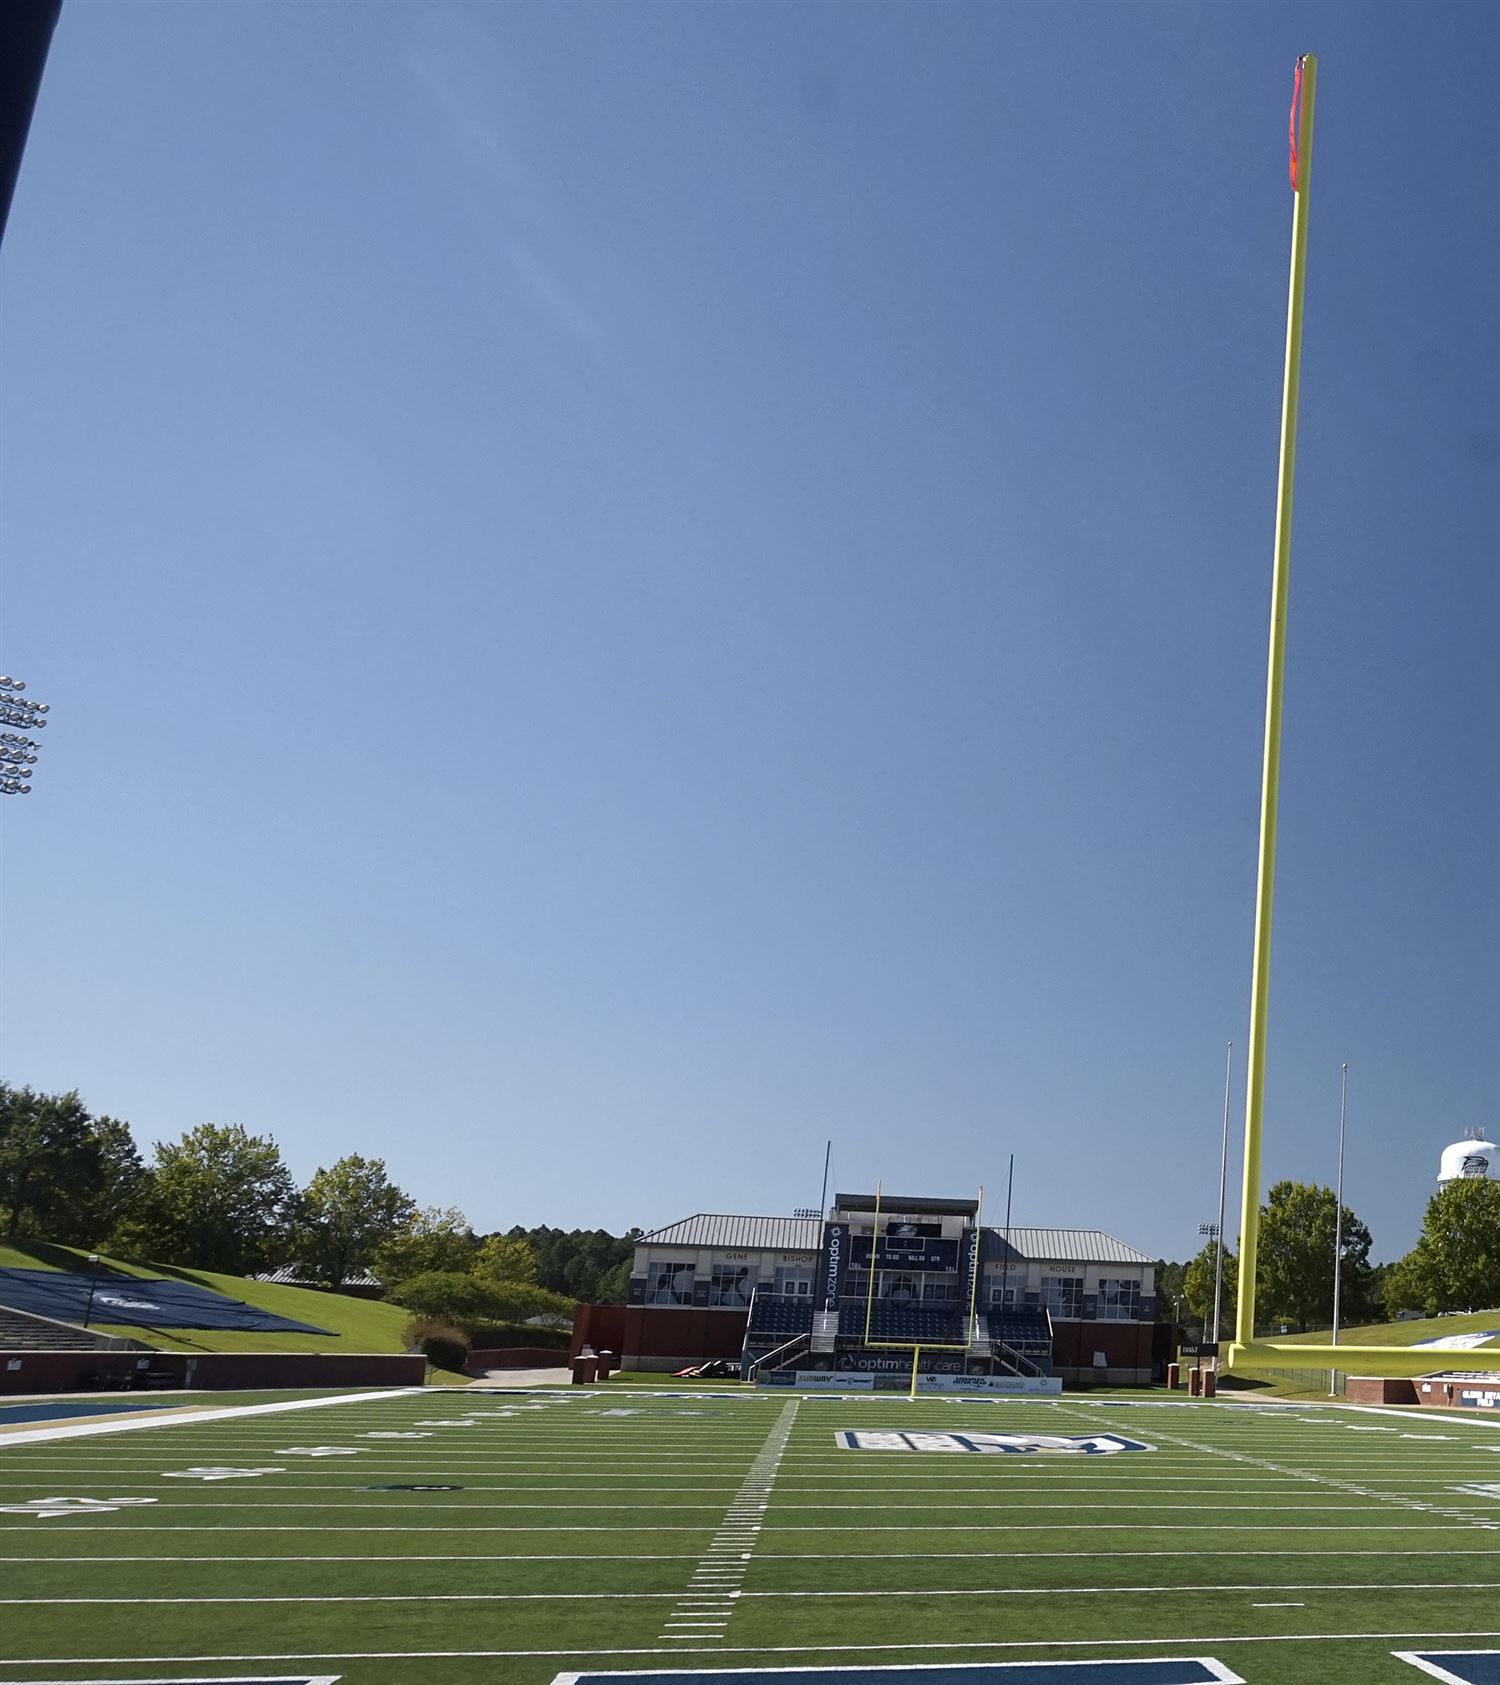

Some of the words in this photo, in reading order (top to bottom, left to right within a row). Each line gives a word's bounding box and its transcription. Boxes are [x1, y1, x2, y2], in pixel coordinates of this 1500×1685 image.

[726, 1252, 748, 1261] GENE
[783, 1255, 813, 1263] BISHOP
[1050, 1264, 1075, 1273] HOUSE
